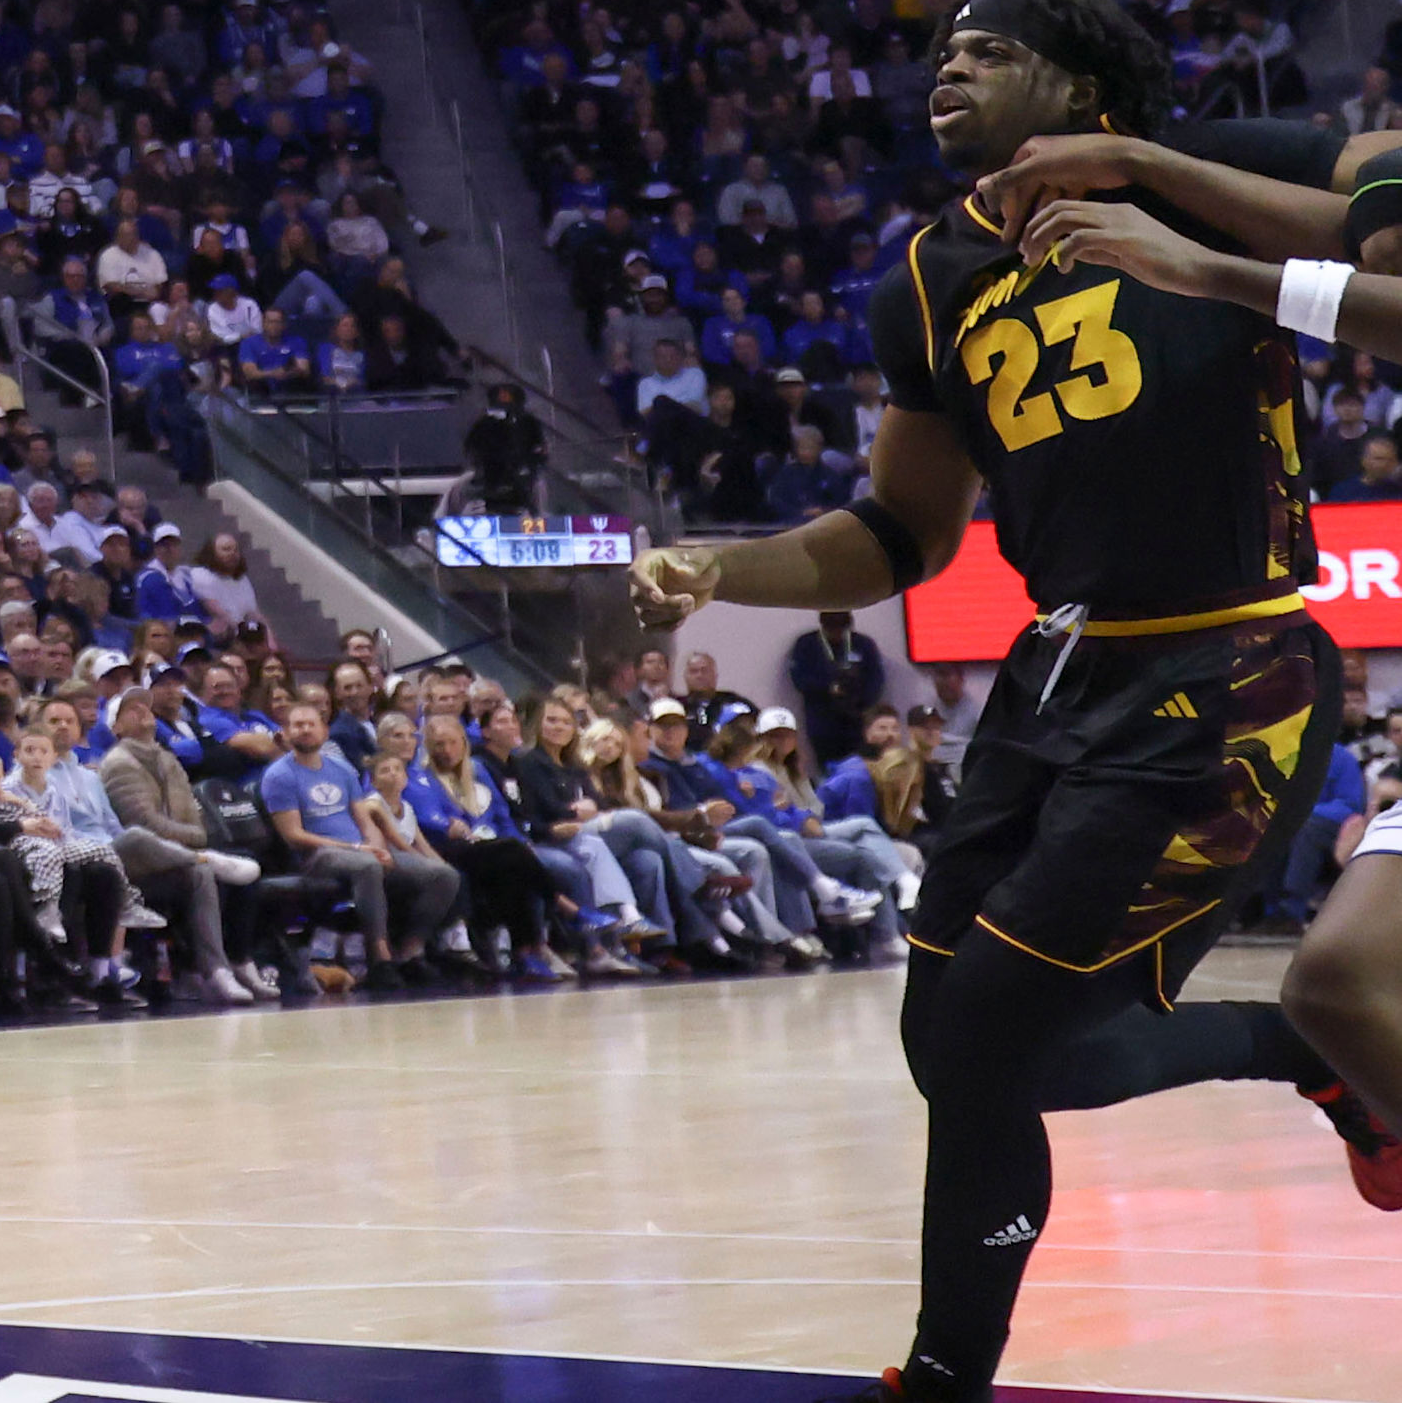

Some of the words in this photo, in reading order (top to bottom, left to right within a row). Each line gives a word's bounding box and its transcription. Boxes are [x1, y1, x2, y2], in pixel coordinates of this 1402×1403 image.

[960, 278, 1143, 453] 23
[589, 540, 617, 561] 23
[983, 1228, 1038, 1247] adidas
